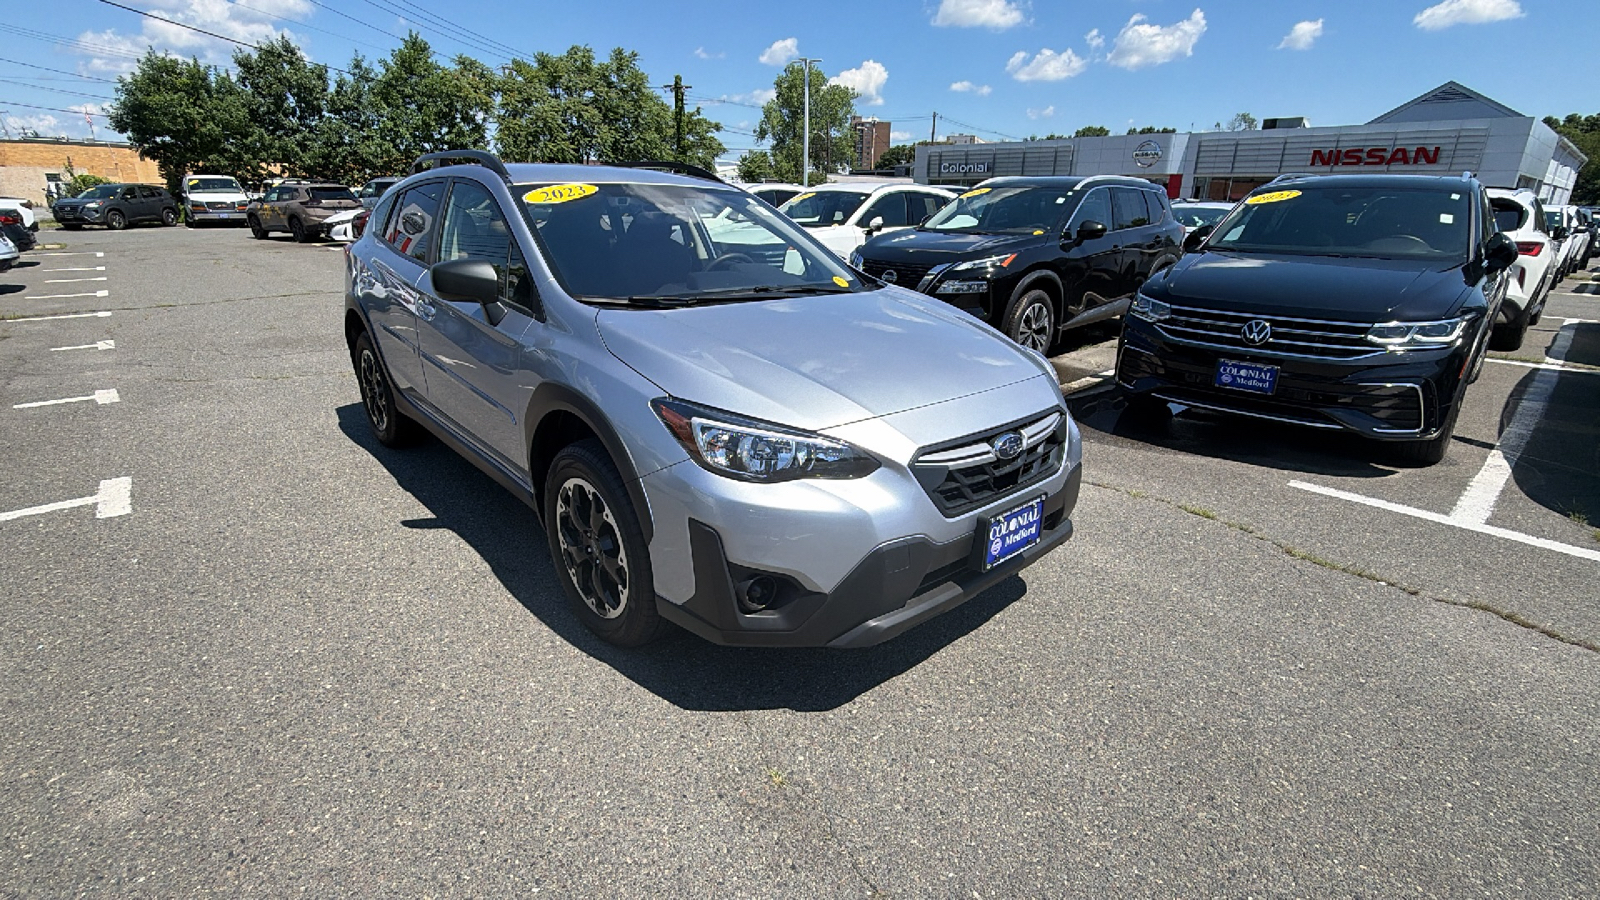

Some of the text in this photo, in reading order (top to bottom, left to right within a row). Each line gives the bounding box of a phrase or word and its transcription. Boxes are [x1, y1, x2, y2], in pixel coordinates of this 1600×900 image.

[1309, 146, 1441, 166] NISSAN
[941, 161, 988, 173] Colonial
[539, 185, 586, 202] 2023
[1235, 377, 1269, 388] Medford
[1004, 523, 1037, 547] Medford
